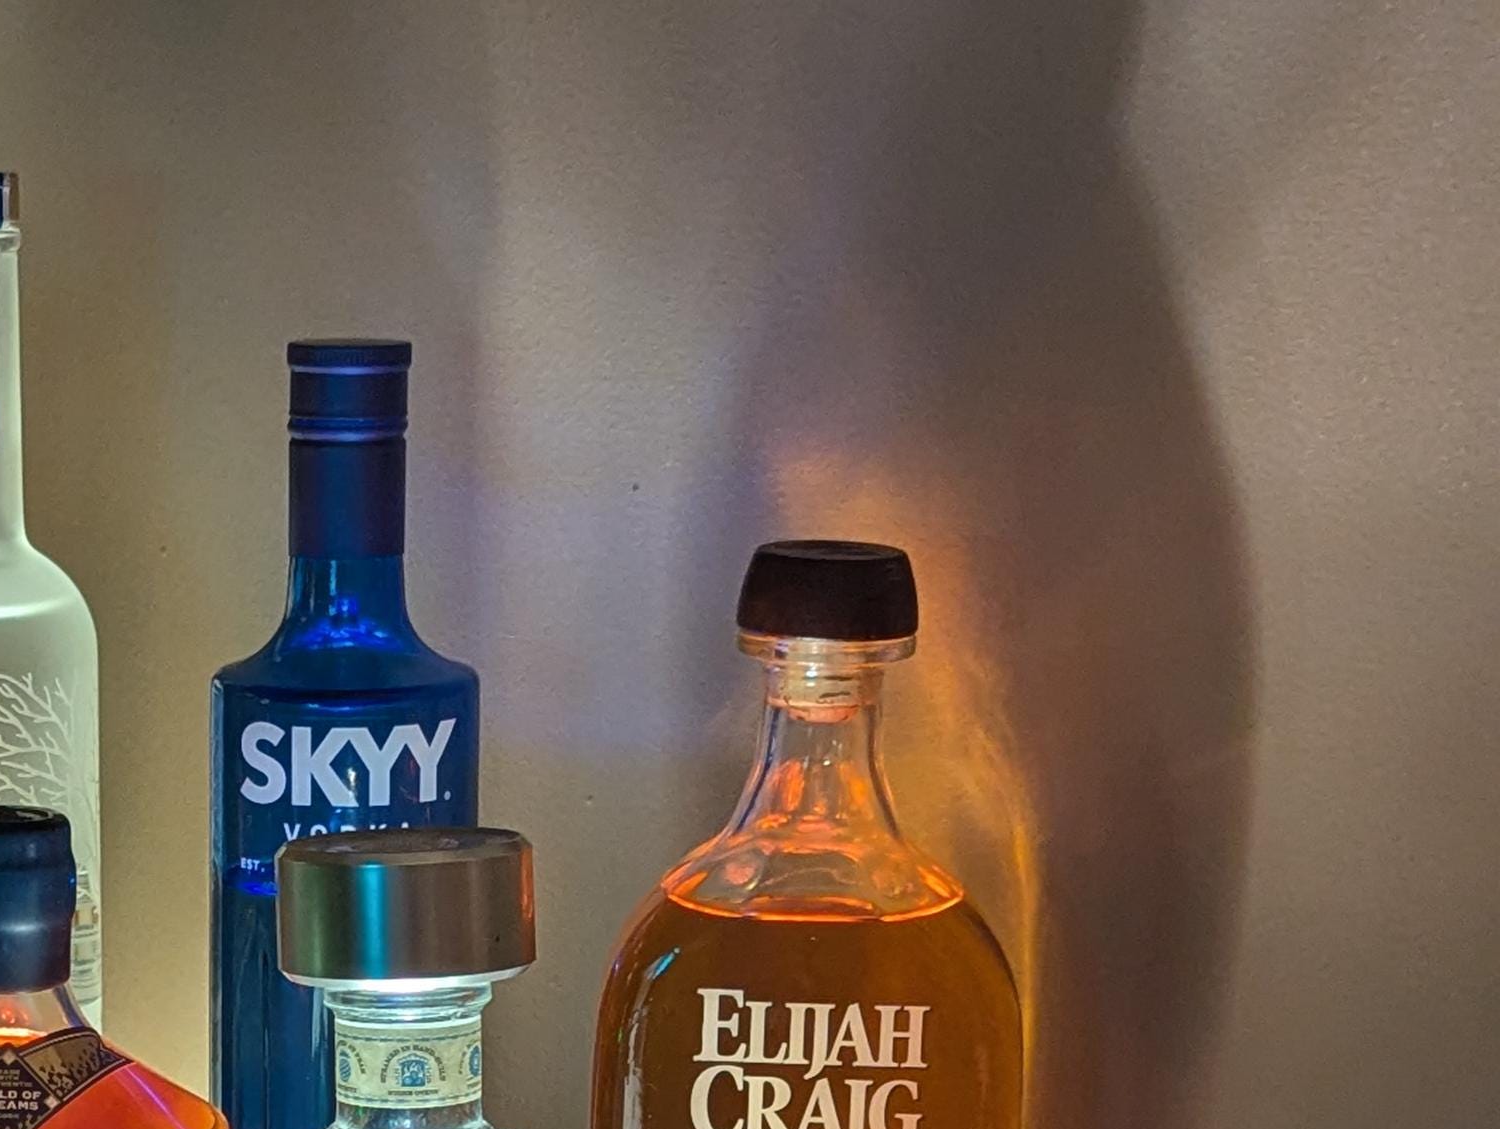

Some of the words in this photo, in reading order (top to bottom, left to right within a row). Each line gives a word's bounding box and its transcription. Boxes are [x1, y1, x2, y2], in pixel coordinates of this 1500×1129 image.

[240, 717, 457, 808] SKYY
[693, 988, 931, 1080] ELIJAH
[22, 1091, 41, 1100] OF
